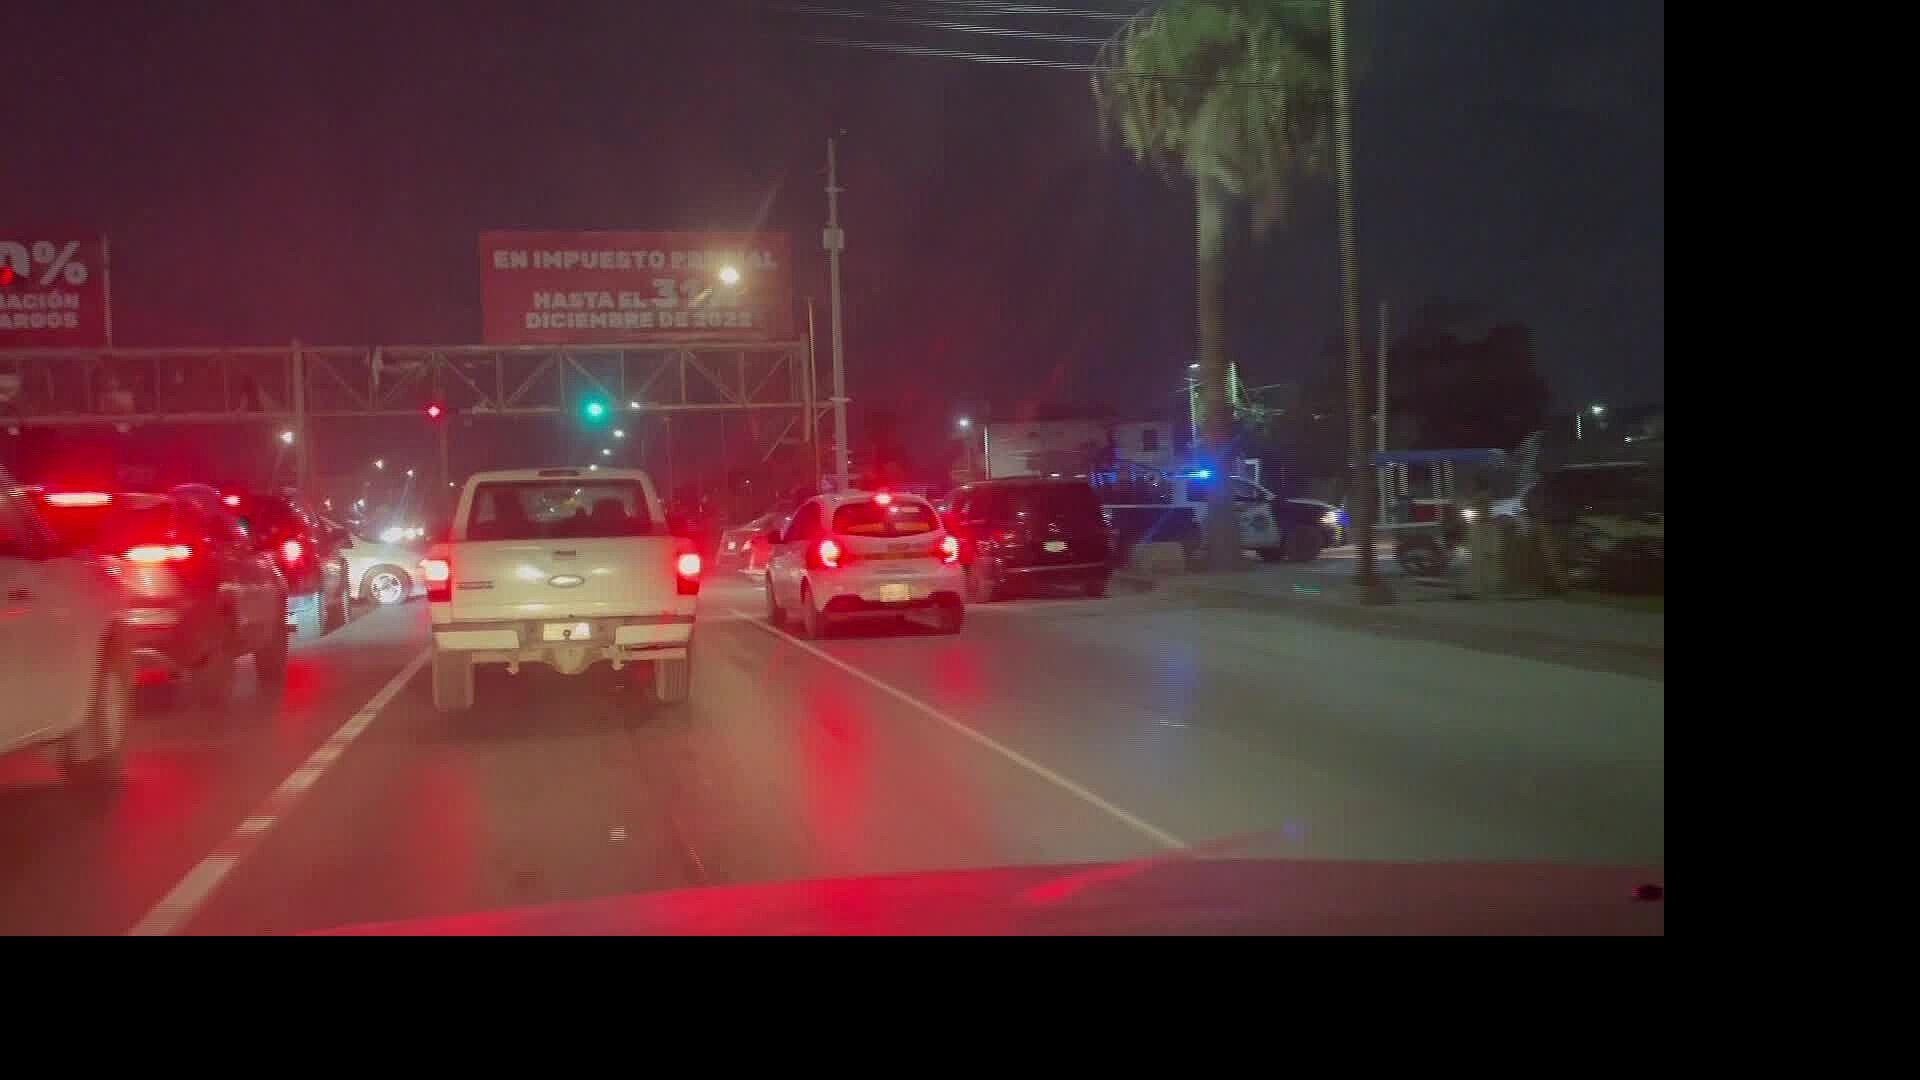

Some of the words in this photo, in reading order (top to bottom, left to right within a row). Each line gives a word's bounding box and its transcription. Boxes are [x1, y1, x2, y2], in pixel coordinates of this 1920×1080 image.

[494, 250, 528, 269] EN
[533, 250, 665, 271] IMPUESTO
[533, 291, 615, 309] HASTA
[618, 291, 646, 308] EL
[526, 312, 654, 328] DICIEMBRE
[659, 312, 688, 328] DE
